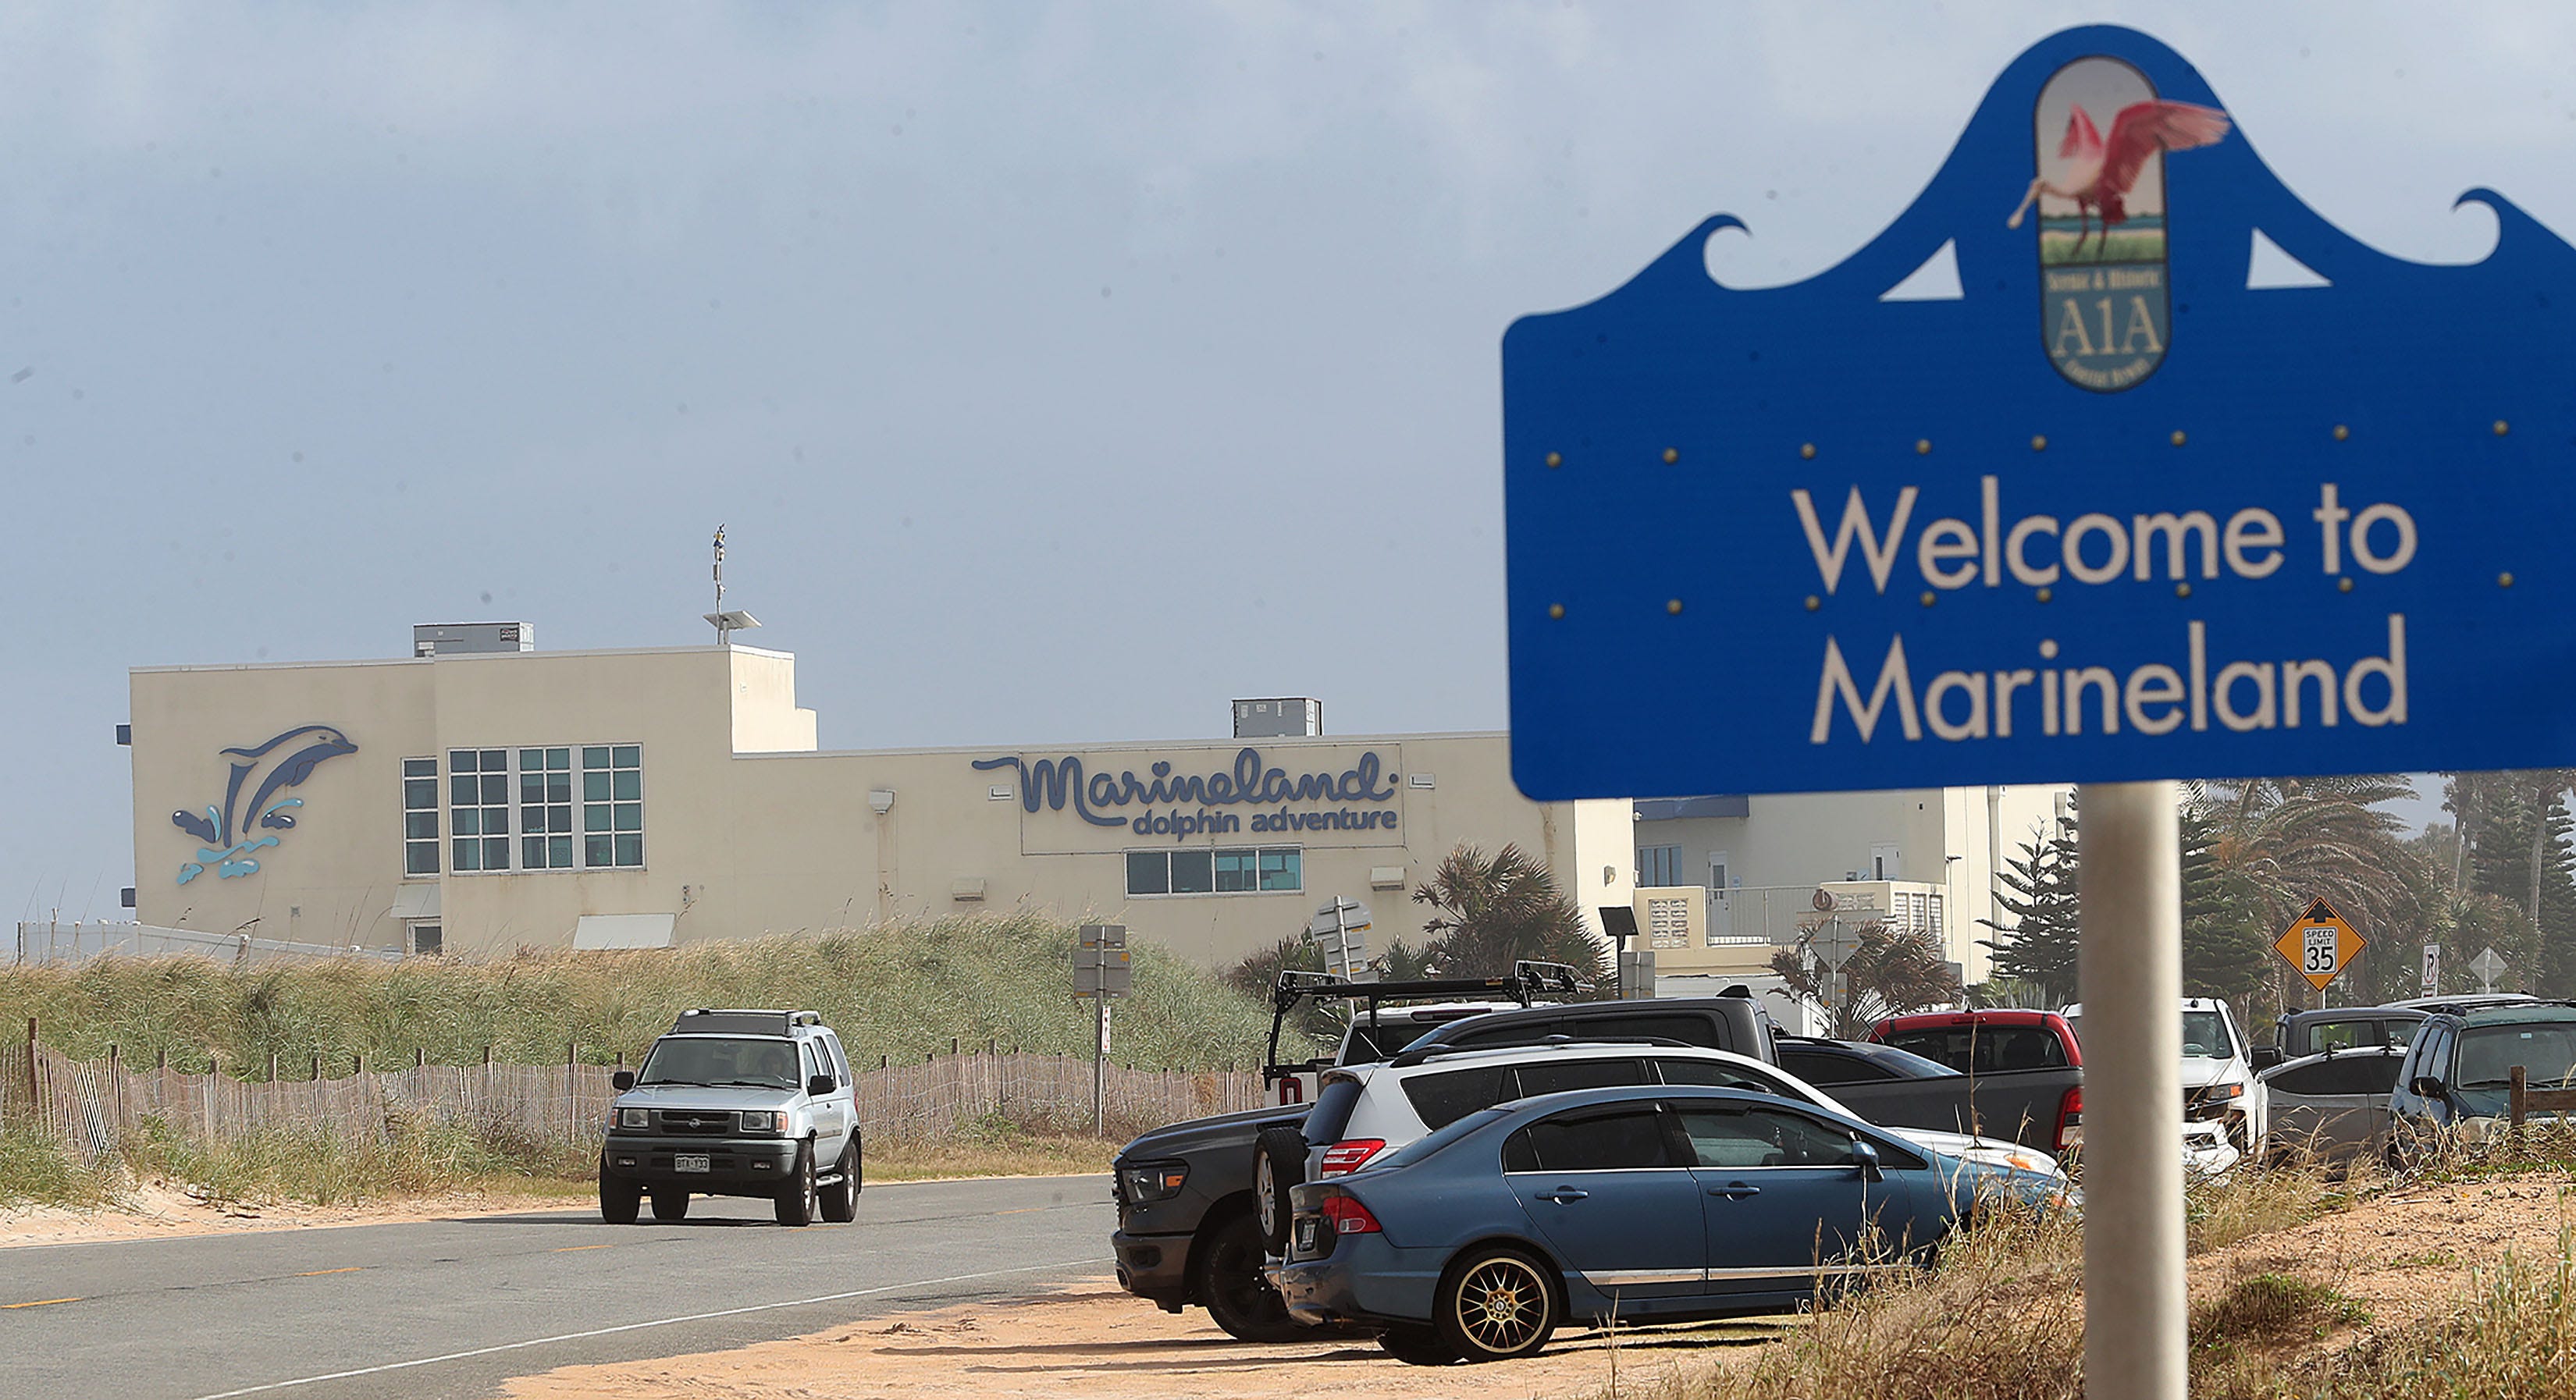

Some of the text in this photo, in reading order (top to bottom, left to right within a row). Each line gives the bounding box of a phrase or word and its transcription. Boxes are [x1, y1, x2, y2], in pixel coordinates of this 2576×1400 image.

[2052, 294, 2164, 357] A1A
[1791, 474, 2418, 595] Welcome to
[1809, 613, 2408, 744] Marineland
[972, 748, 1398, 826] Marineland
[1133, 805, 1398, 842] dolphin adventure
[2306, 929, 2334, 938] SPEED
[2306, 946, 2334, 971] 35
